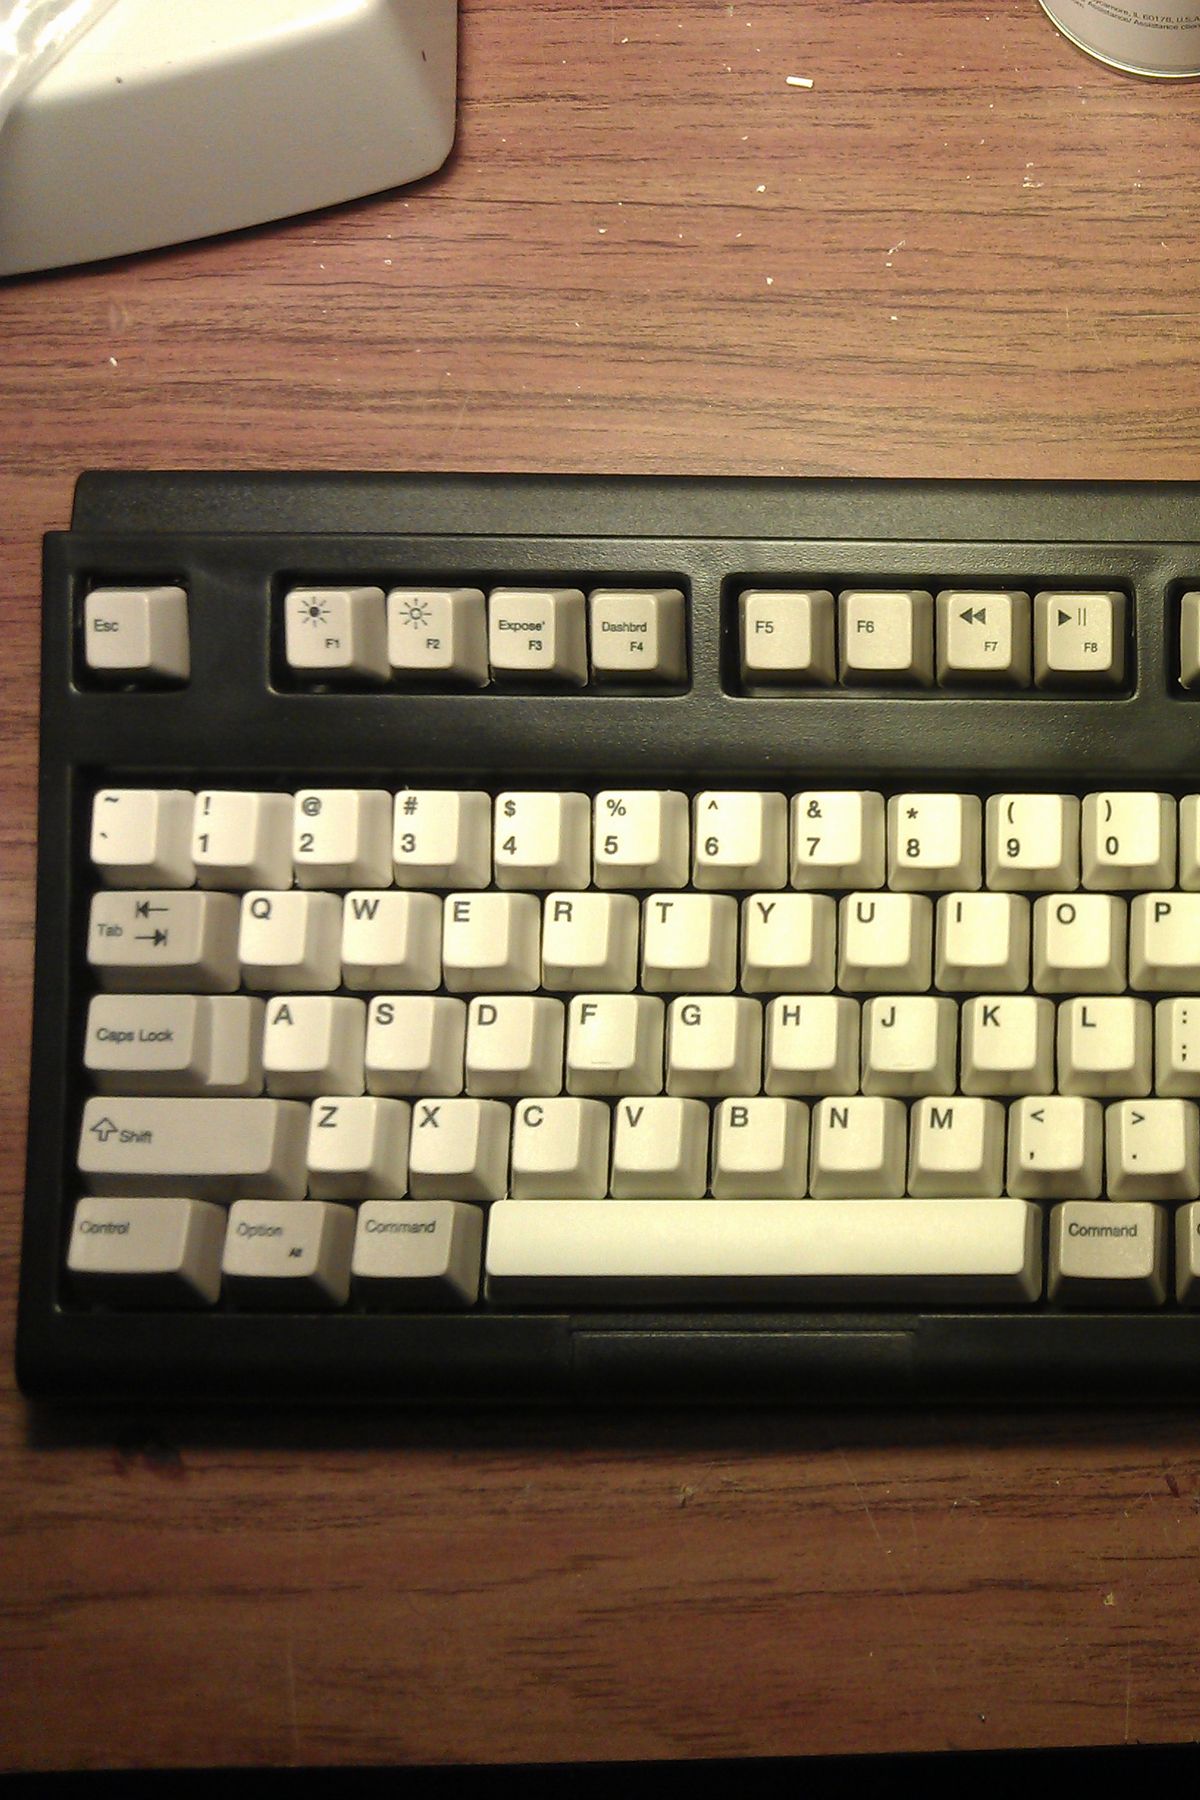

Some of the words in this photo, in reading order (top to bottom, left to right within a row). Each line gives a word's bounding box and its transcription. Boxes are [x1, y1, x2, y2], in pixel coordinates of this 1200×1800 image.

[93, 618, 119, 633] Esc
[601, 620, 648, 633] Dashbrd
[755, 619, 775, 634] F5
[856, 619, 875, 634] F6
[325, 638, 340, 649] F1
[426, 638, 441, 650] F2
[528, 639, 543, 652] F3
[629, 640, 644, 652] F4
[984, 640, 999, 652] F7
[1083, 641, 1099, 653] F8
[203, 796, 212, 816] !
[301, 796, 322, 817] @
[403, 796, 419, 816] #
[503, 799, 516, 818] $
[606, 798, 627, 817] %
[707, 799, 719, 810] ^
[806, 799, 823, 819] &
[198, 833, 209, 853] 1
[299, 832, 315, 853] 2
[400, 832, 416, 854] 3
[502, 835, 518, 856] 4
[603, 835, 619, 855] 5
[704, 836, 719, 857] 6
[806, 836, 821, 857] 7
[906, 838, 921, 858] 8
[1006, 837, 1021, 858] 9
[1105, 835, 1119, 856] 0
[249, 897, 272, 921] Q
[351, 898, 381, 921] W
[453, 900, 471, 923] E
[553, 900, 573, 923] R
[655, 901, 674, 924] T
[756, 901, 776, 924] Y
[856, 901, 876, 924] U
[1056, 902, 1077, 925] O
[1154, 901, 1172, 923] P
[96, 923, 124, 937] Tab
[271, 1003, 294, 1026] A
[375, 1002, 395, 1026] S
[477, 1003, 498, 1026] D
[580, 1003, 598, 1025] F
[680, 1003, 701, 1026] G
[782, 1004, 801, 1027] H
[880, 1006, 896, 1028] J
[982, 1004, 1001, 1027] K
[1081, 1005, 1097, 1028] L
[95, 1027, 135, 1045] Caps
[138, 1029, 174, 1043] Lock
[317, 1105, 339, 1129] Z
[419, 1105, 441, 1129] X
[523, 1104, 544, 1128] C
[625, 1105, 645, 1128] V
[729, 1105, 749, 1128] B
[829, 1107, 849, 1129] N
[929, 1107, 954, 1130] M
[1029, 1108, 1045, 1123] <
[1131, 1111, 1146, 1126] >
[119, 1129, 153, 1144] Shift
[79, 1220, 131, 1235] Control
[235, 1221, 283, 1240] Option
[364, 1218, 437, 1234] Command
[1067, 1221, 1138, 1238] Command
